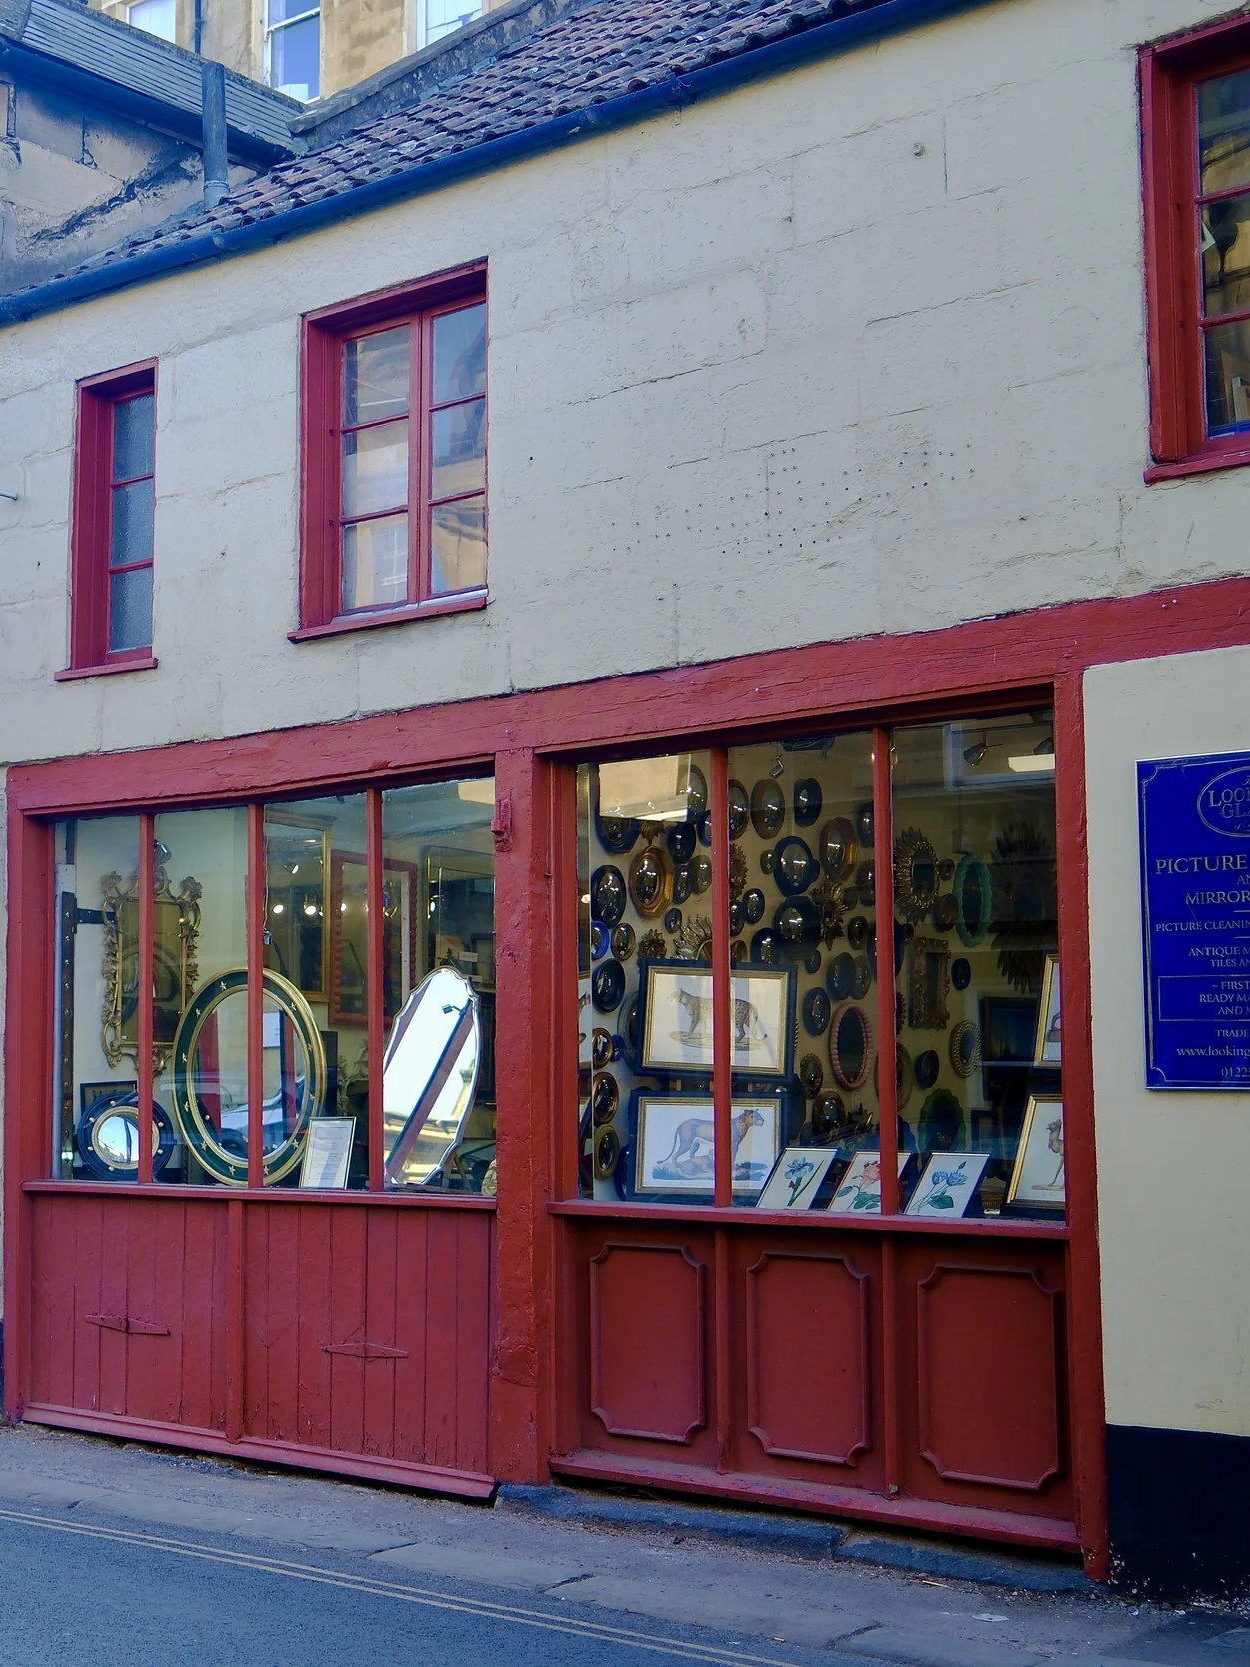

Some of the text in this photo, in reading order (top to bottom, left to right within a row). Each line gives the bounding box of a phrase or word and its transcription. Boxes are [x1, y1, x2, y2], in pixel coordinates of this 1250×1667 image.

[1155, 854, 1248, 875] PICTURE
[1155, 921, 1203, 932] PICTURE
[1188, 946, 1241, 957] ANTIQUE
[1210, 958, 1237, 968] TILES
[1221, 980, 1250, 990] FIRST
[1199, 993, 1235, 1003] READY
[1217, 1005, 1244, 1015] AND
[1215, 1029, 1250, 1038] TRADE
